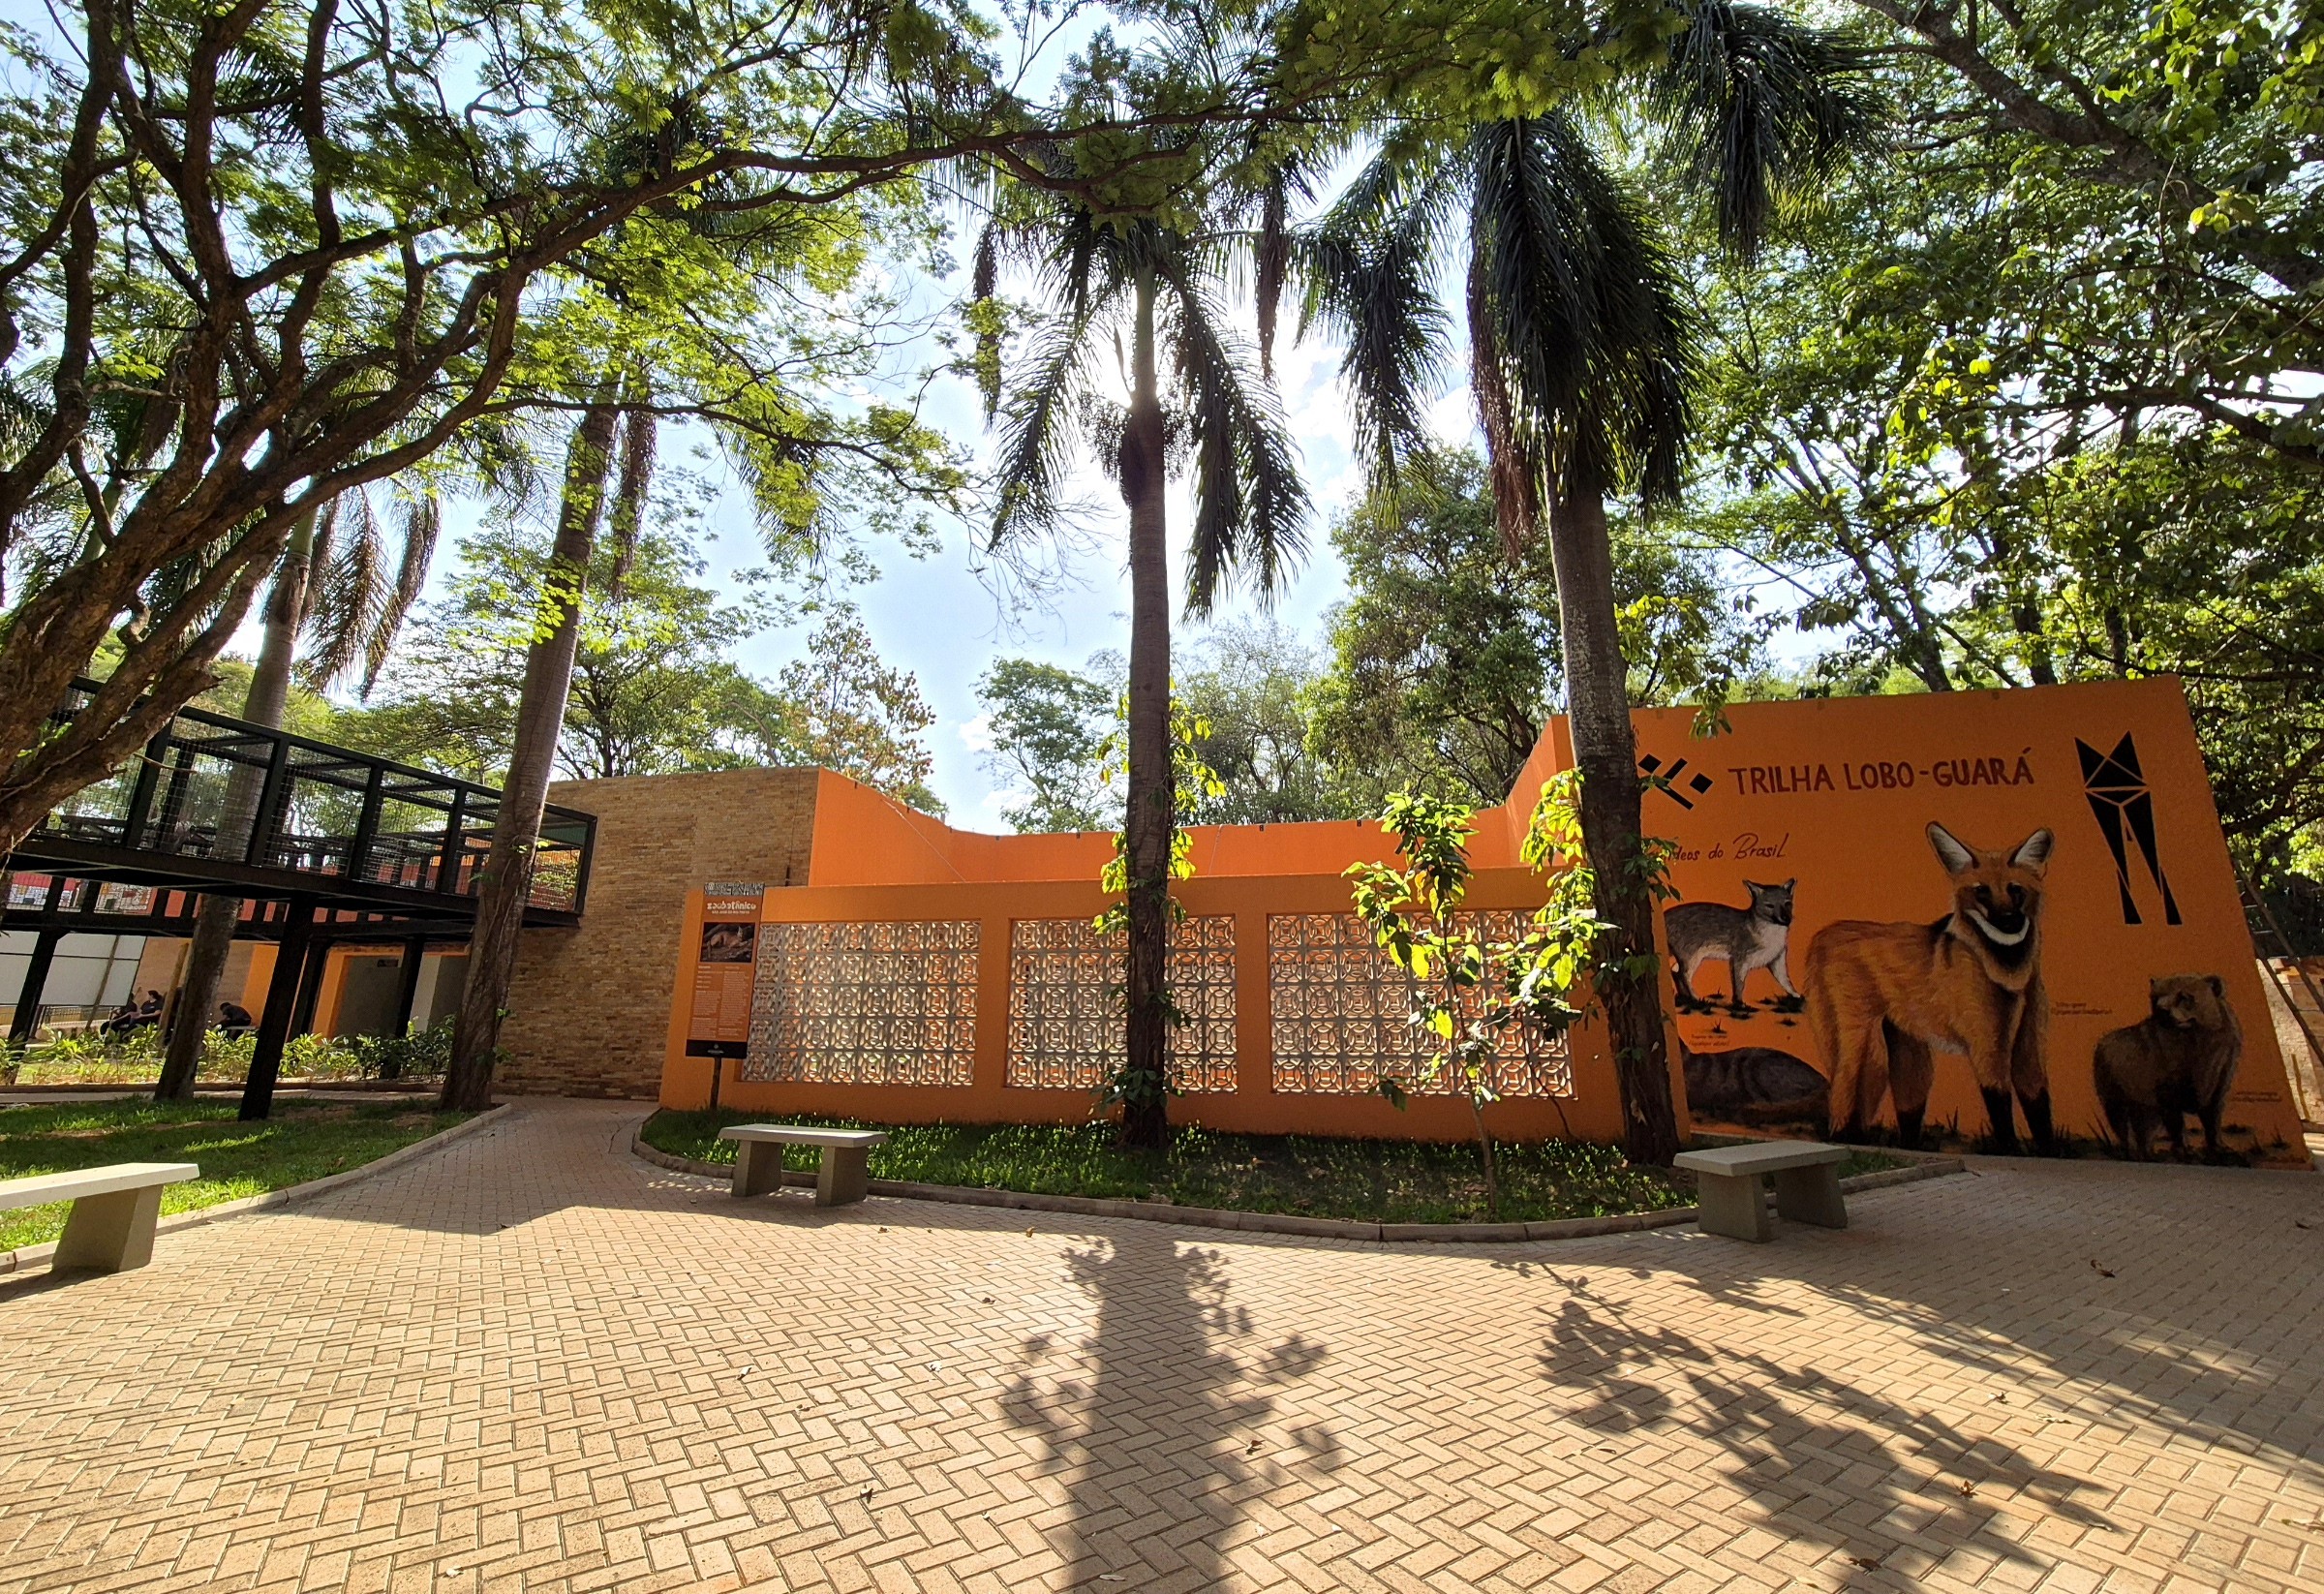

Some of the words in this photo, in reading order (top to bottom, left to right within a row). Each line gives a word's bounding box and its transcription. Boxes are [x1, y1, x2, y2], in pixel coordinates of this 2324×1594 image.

[1728, 764, 1835, 795] TRILHA
[1844, 747, 2034, 790] LOBO-GUARÁ
[1708, 843, 1724, 860] do
